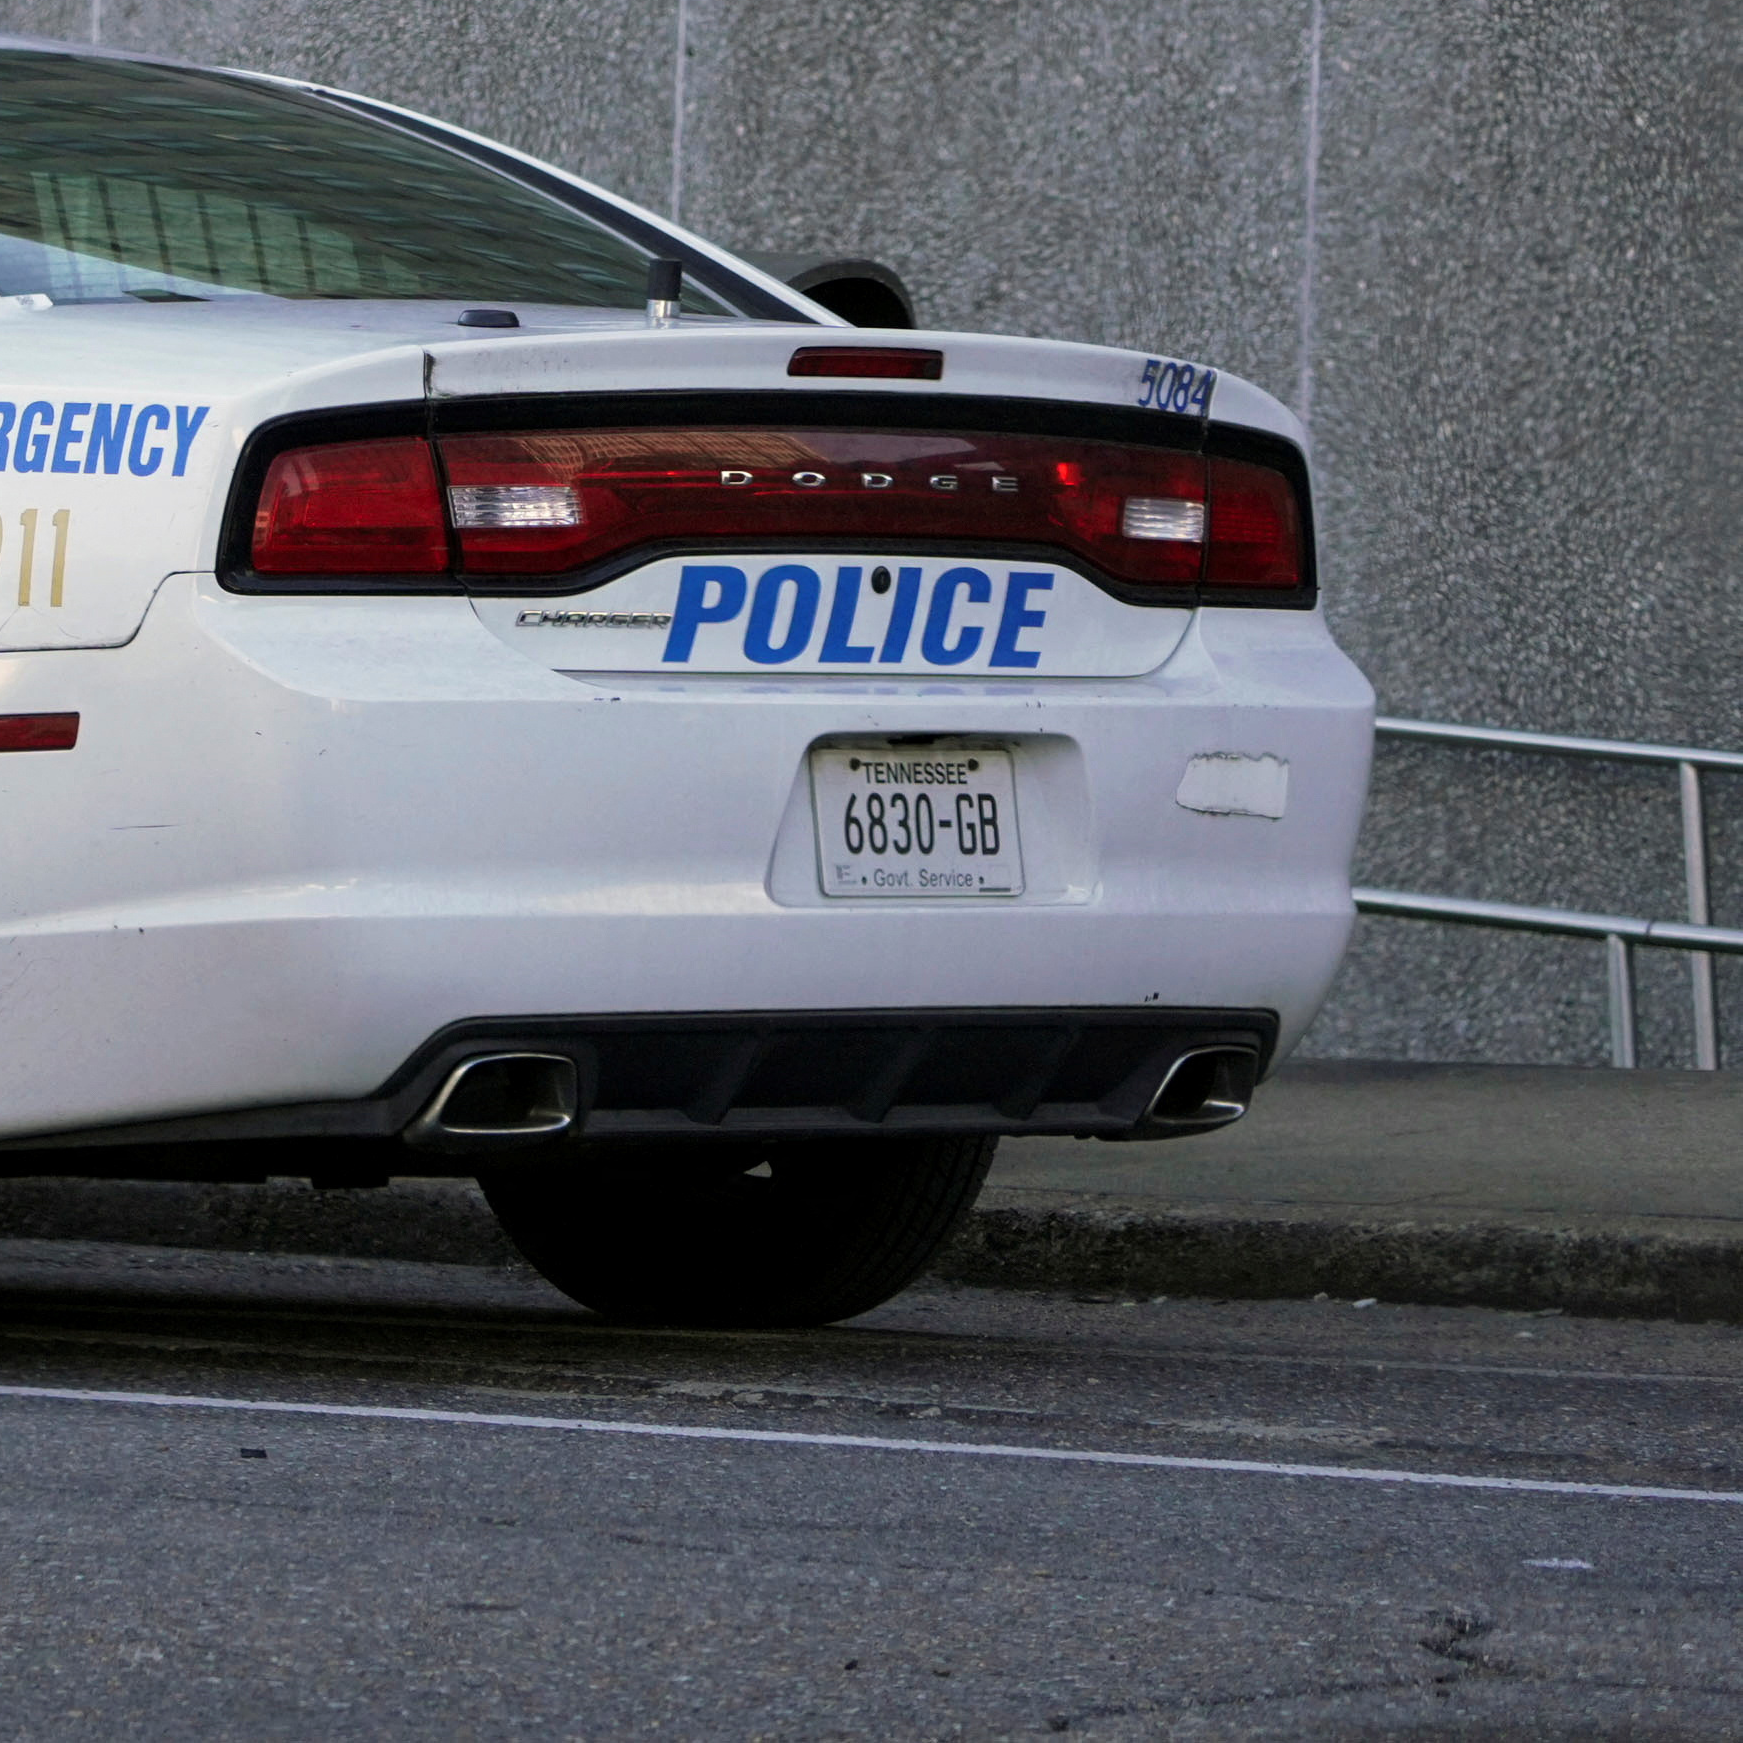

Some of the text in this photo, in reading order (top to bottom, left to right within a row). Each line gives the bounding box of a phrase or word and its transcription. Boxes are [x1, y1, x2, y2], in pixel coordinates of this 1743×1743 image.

[1137, 358, 1213, 418] 5084
[720, 469, 1019, 493] DODGE
[516, 610, 674, 630] CHARGER
[661, 563, 1055, 669] POLICE
[863, 761, 969, 785] TENNESSEE
[844, 792, 1001, 856] 6830-GB
[873, 867, 913, 888] Govt.
[918, 867, 974, 888] Service
